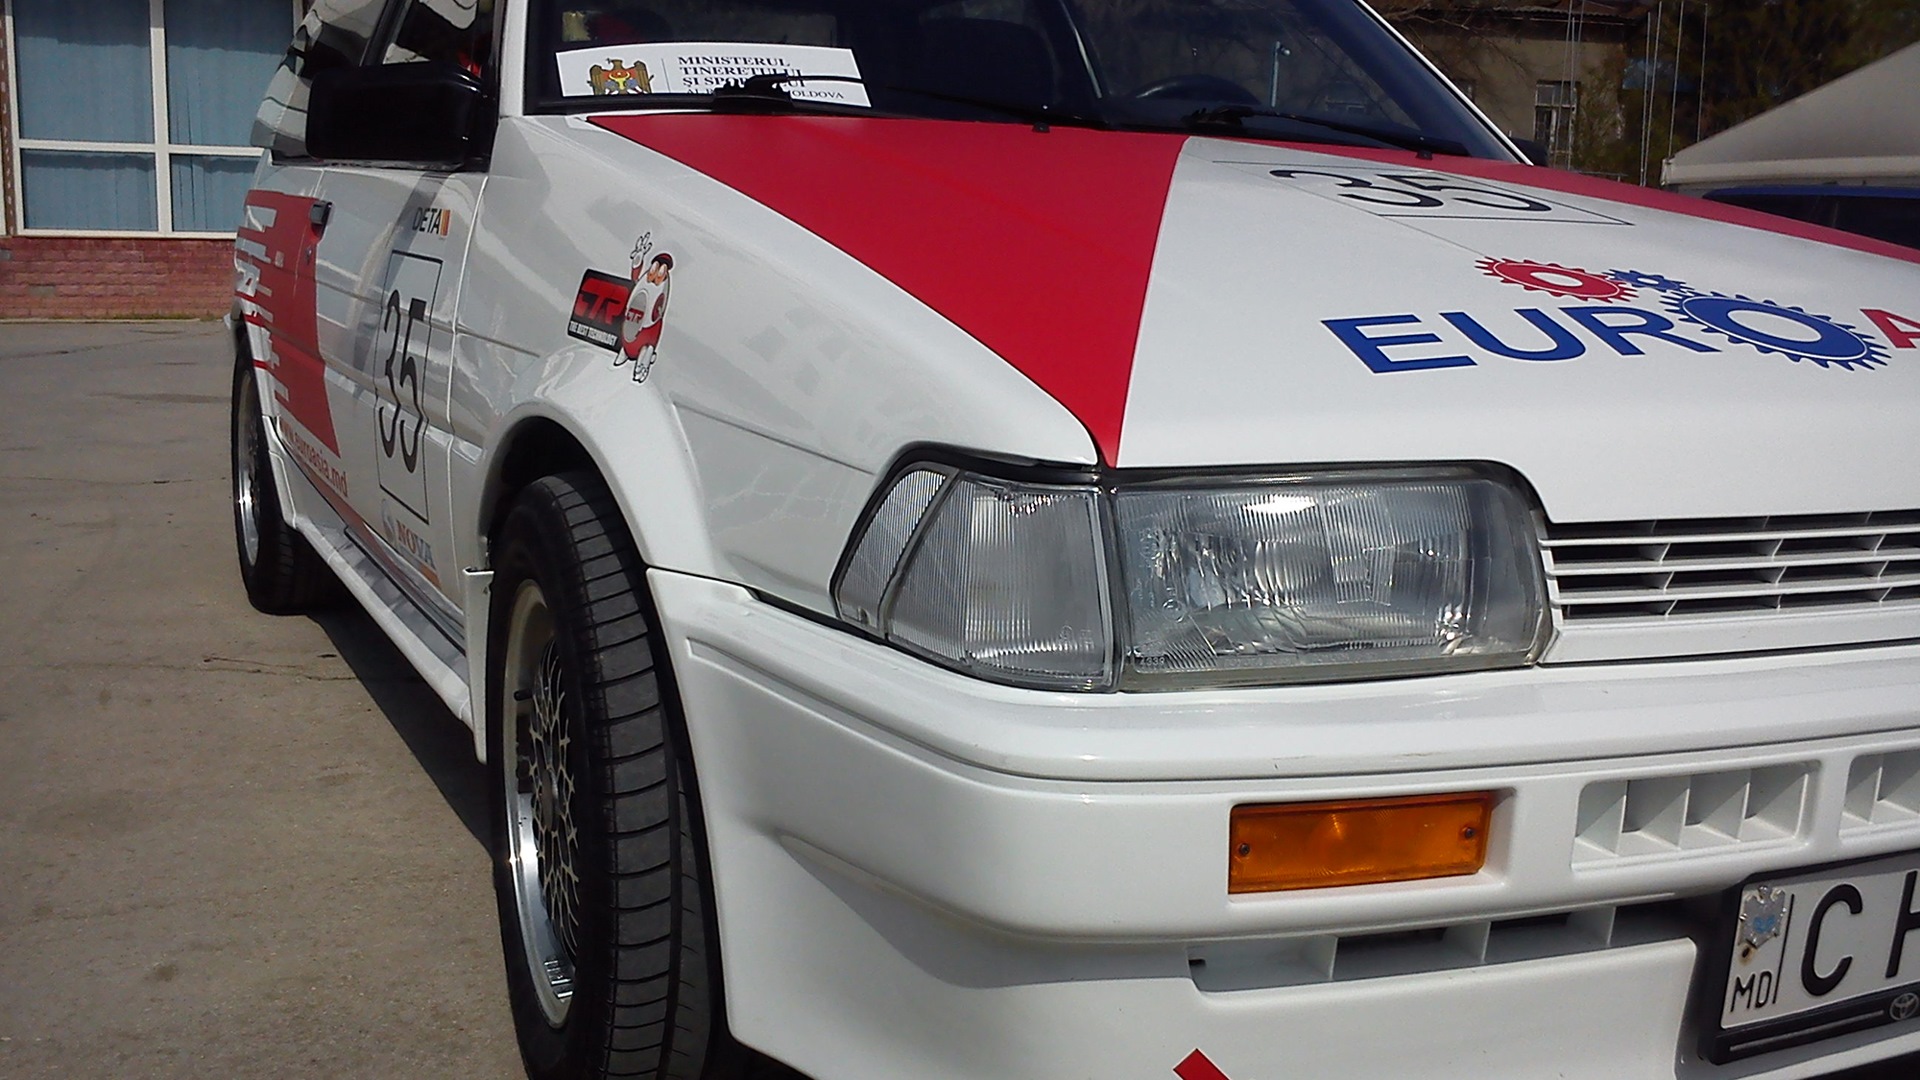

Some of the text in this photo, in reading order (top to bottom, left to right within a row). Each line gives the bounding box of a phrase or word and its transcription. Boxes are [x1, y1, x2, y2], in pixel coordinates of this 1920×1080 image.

[678, 56, 790, 67] MINISTERUL
[791, 90, 844, 99] OLDOVA
[1269, 169, 1552, 212] 35
[412, 207, 443, 235] DETA
[378, 289, 428, 475] 35
[1730, 971, 1772, 1012] MD
